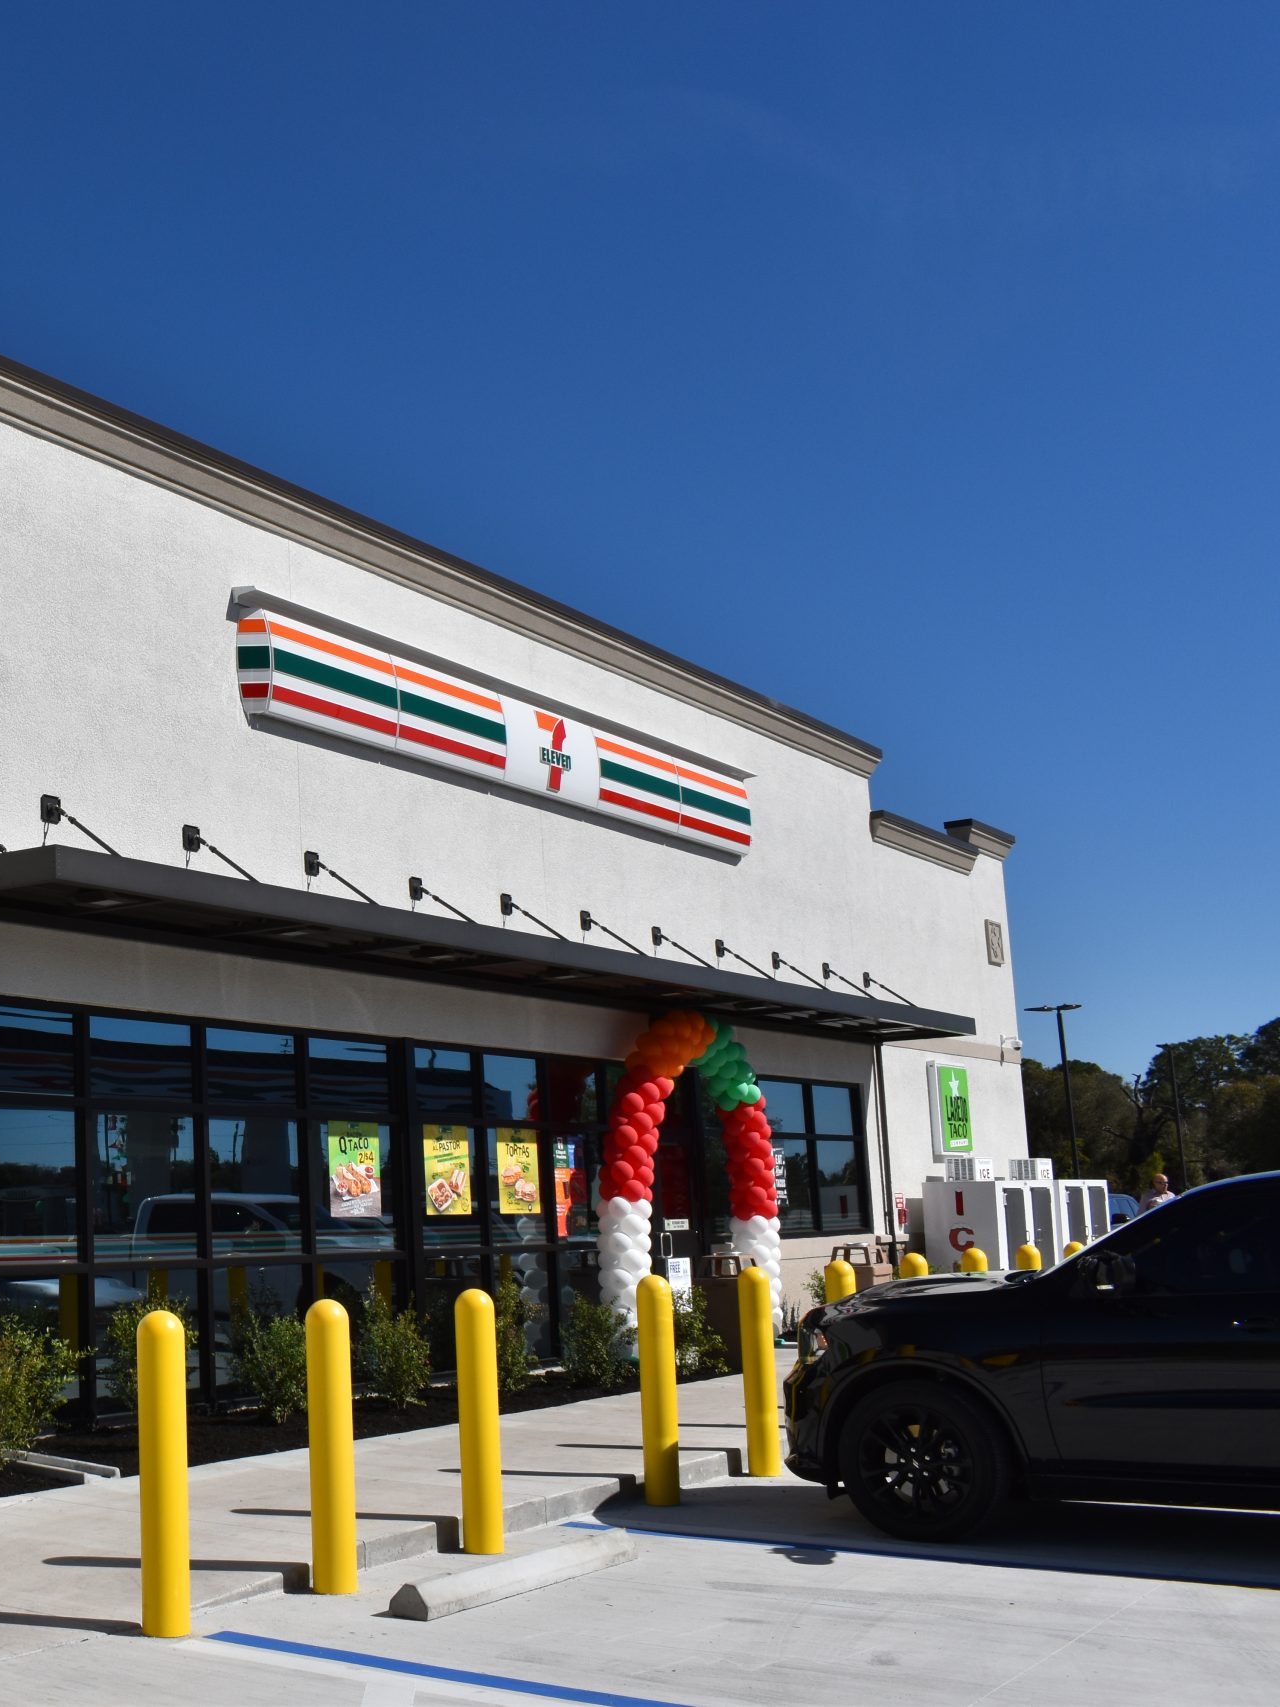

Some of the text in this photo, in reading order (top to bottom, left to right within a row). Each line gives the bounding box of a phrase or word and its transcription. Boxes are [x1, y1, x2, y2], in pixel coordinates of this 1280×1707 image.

[534, 710, 567, 792] 7
[948, 1123, 968, 1139] TACO
[348, 1137, 369, 1151] TACO
[438, 1141, 461, 1152] PASTOR
[505, 1143, 529, 1158] TORTAS
[979, 1168, 991, 1179] ICE
[1040, 1169, 1051, 1180] ICE
